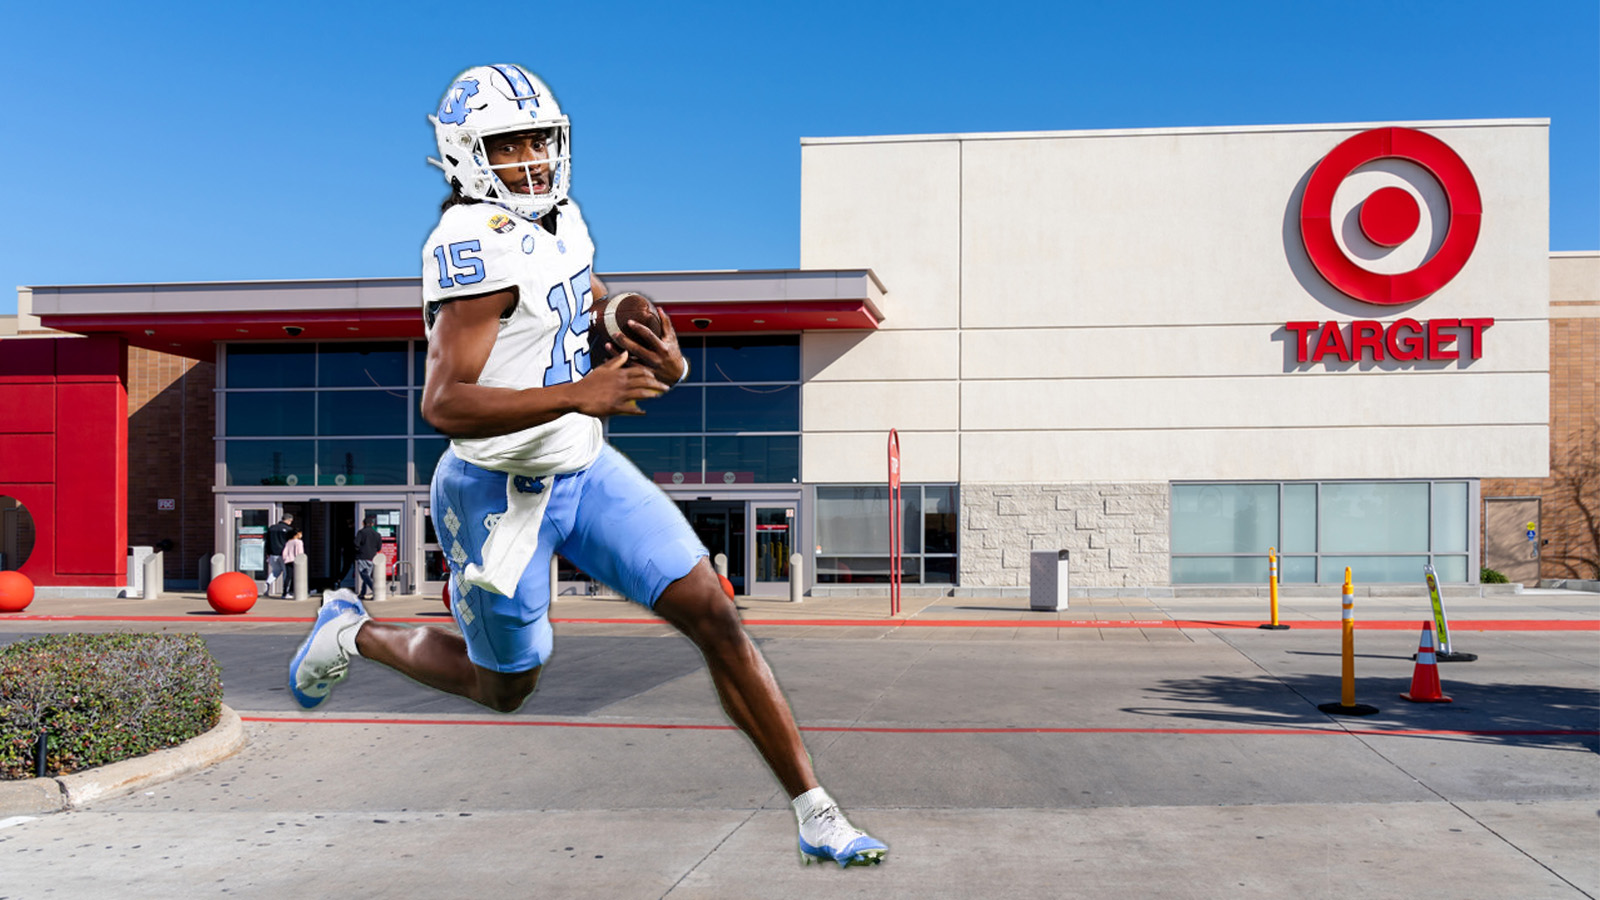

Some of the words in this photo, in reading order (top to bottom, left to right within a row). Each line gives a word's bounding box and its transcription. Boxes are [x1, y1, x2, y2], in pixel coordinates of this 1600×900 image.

[433, 239, 486, 289] 15
[543, 264, 592, 388] 15
[1286, 317, 1495, 362] TARGET
